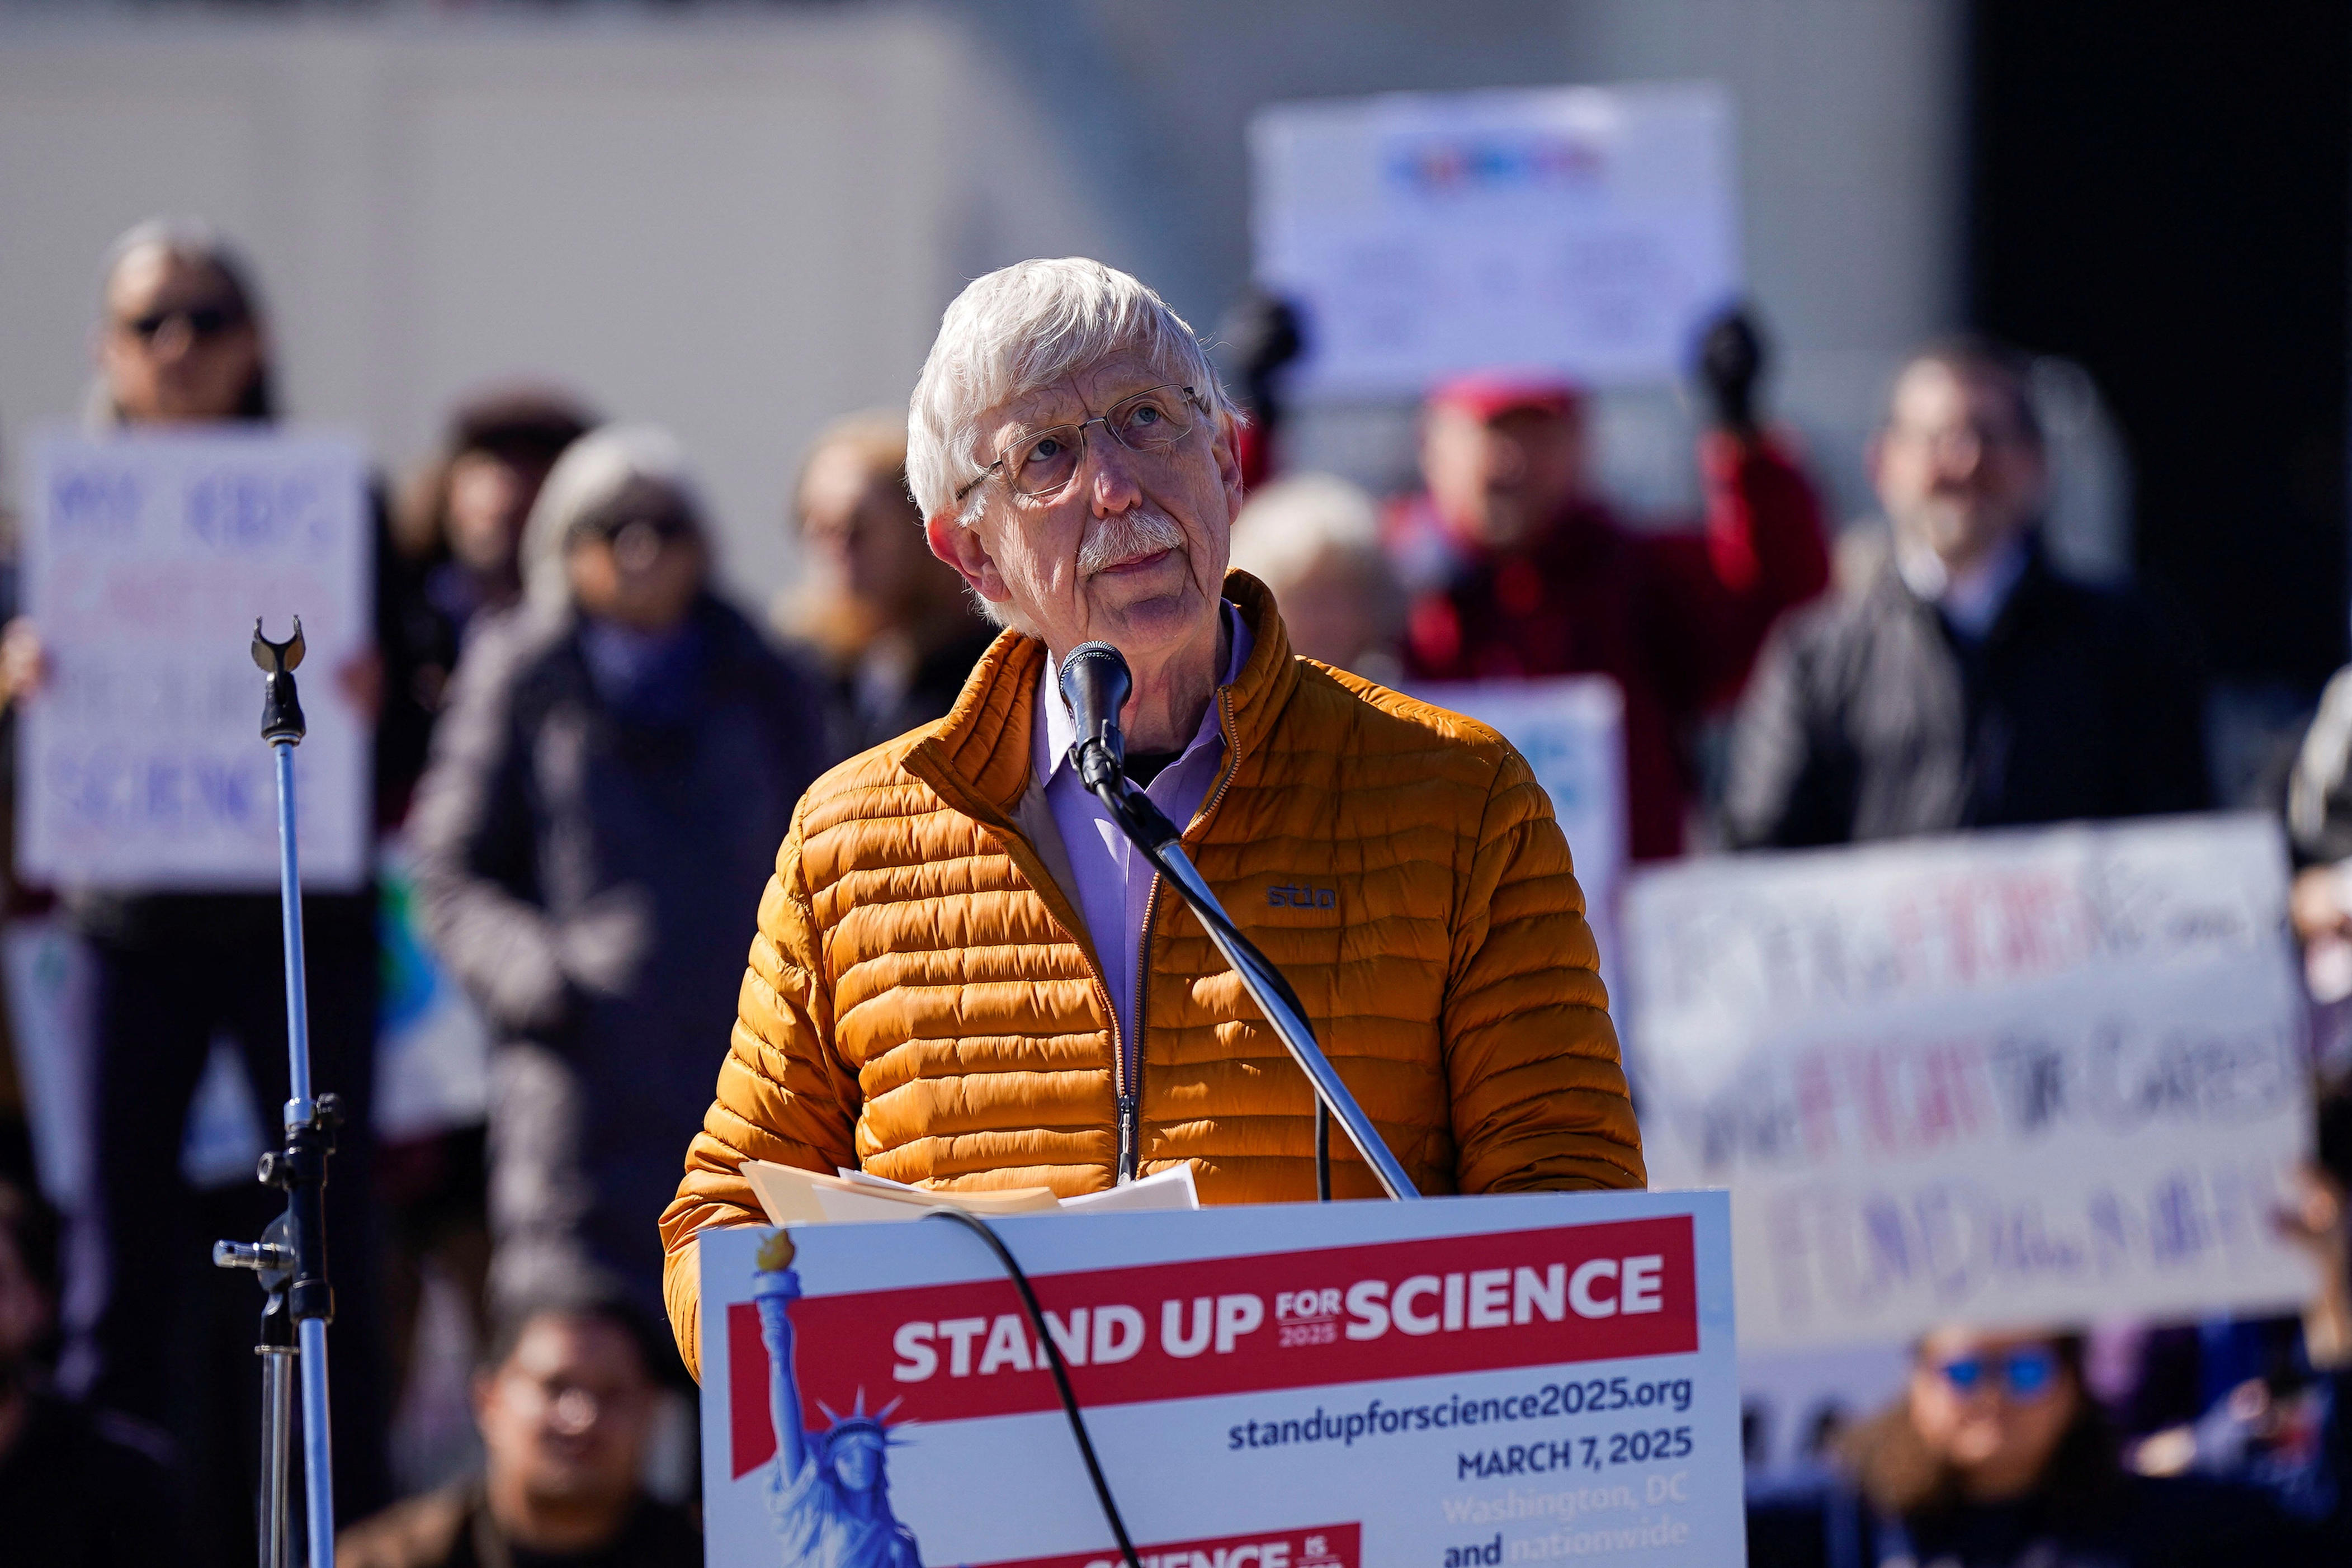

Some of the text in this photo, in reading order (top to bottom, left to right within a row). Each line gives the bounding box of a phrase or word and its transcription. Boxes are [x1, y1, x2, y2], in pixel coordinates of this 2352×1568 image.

[893, 1254, 1663, 1382] STAND UP FOR SCIENCE
[1279, 1322, 1336, 1347] 2025
[1228, 1376, 1693, 1451] standupforscience2025.org
[1457, 1425, 1693, 1481] MARCH 7, 2025
[1441, 1471, 1688, 1523] Washington, DC
[1444, 1514, 1689, 1568] and nationwide
